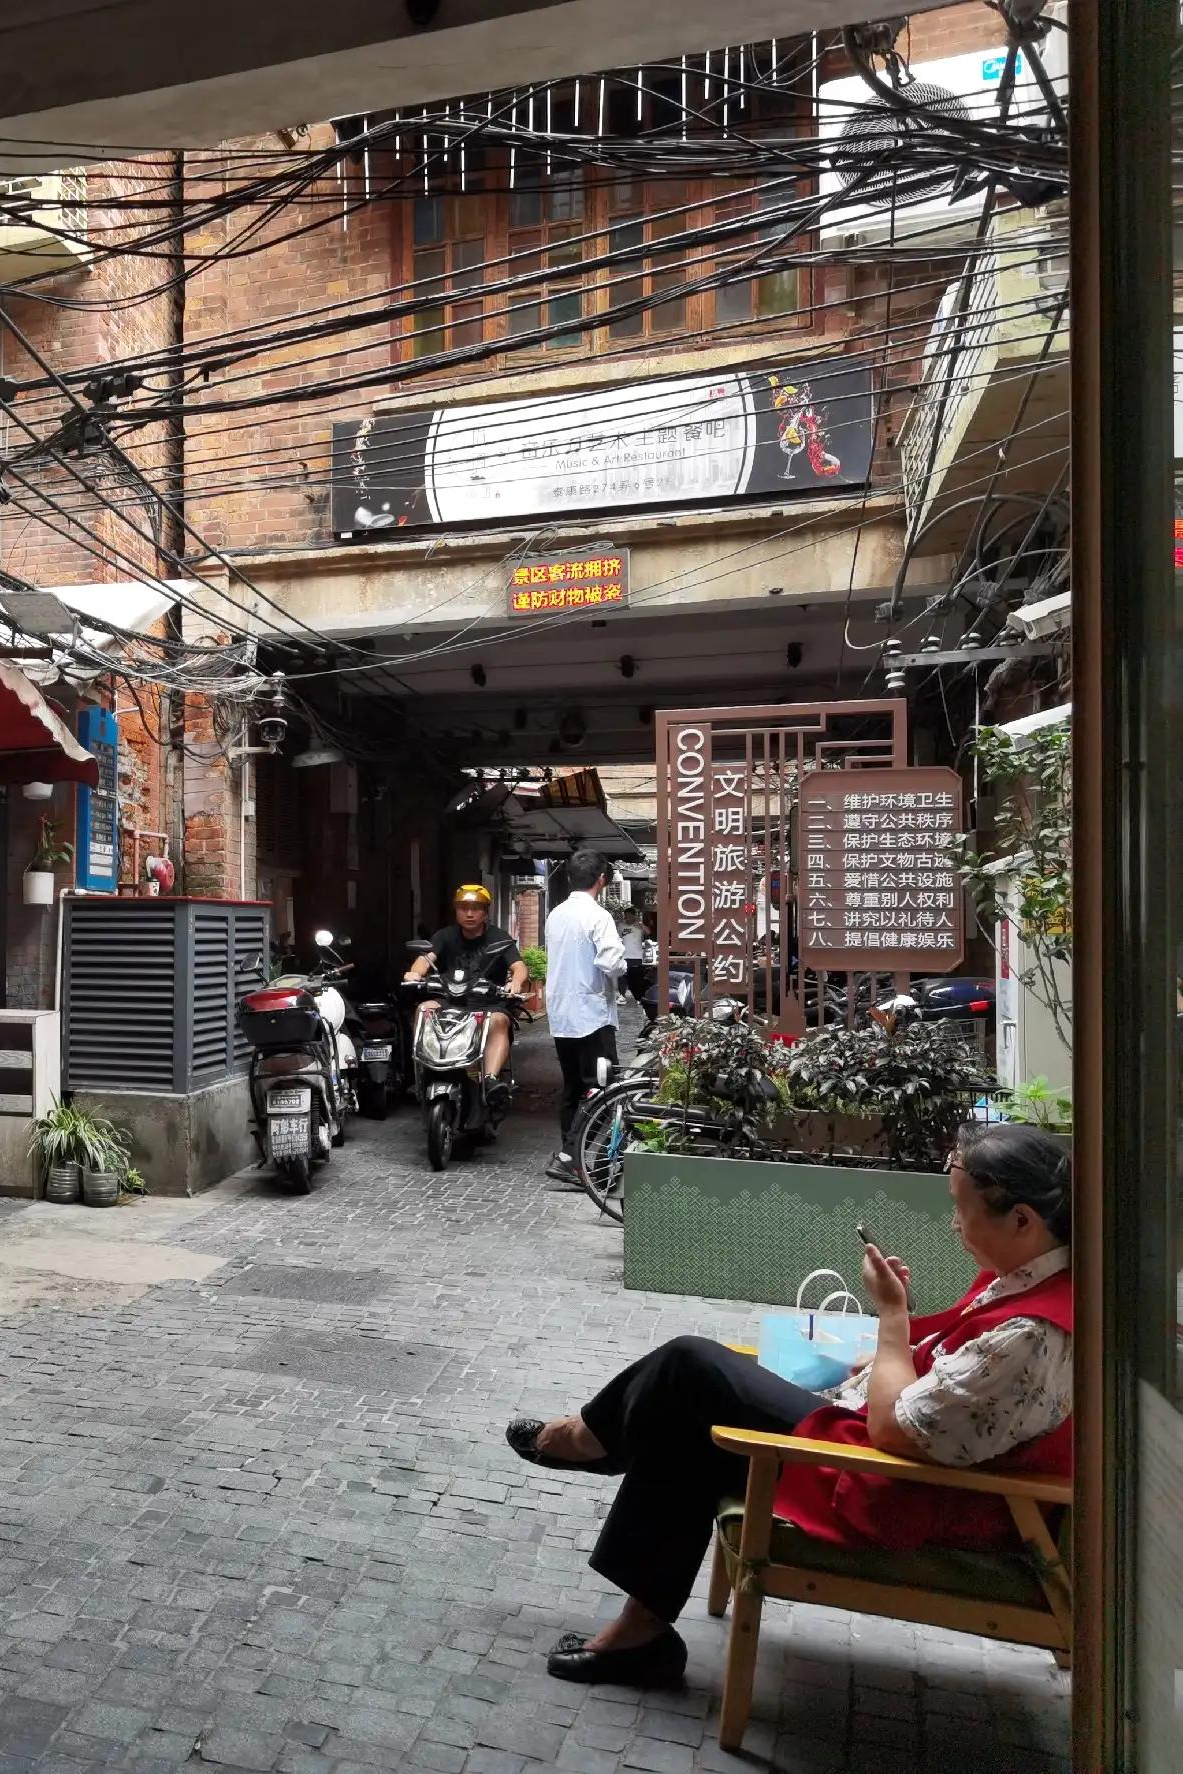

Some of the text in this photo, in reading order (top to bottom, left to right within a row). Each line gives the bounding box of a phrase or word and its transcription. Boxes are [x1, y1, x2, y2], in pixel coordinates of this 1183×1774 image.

[555, 447, 686, 471] Music & Art Restaurant
[513, 557, 622, 586] 景区客流拥挤
[512, 582, 623, 610] 谨防财物被盗
[808, 791, 954, 810] 一、维护环境卫生
[808, 812, 953, 830] 二、遵守公共秩序
[677, 728, 706, 940] CONVENTION
[713, 769, 746, 984] 文明旅游公约
[808, 872, 954, 889] 五、爱惜公共设施
[808, 891, 954, 909] 六、尊重别人权利
[808, 911, 954, 928] 七、讲究以礼待人
[808, 931, 955, 948] 八、提倡健康娱乐
